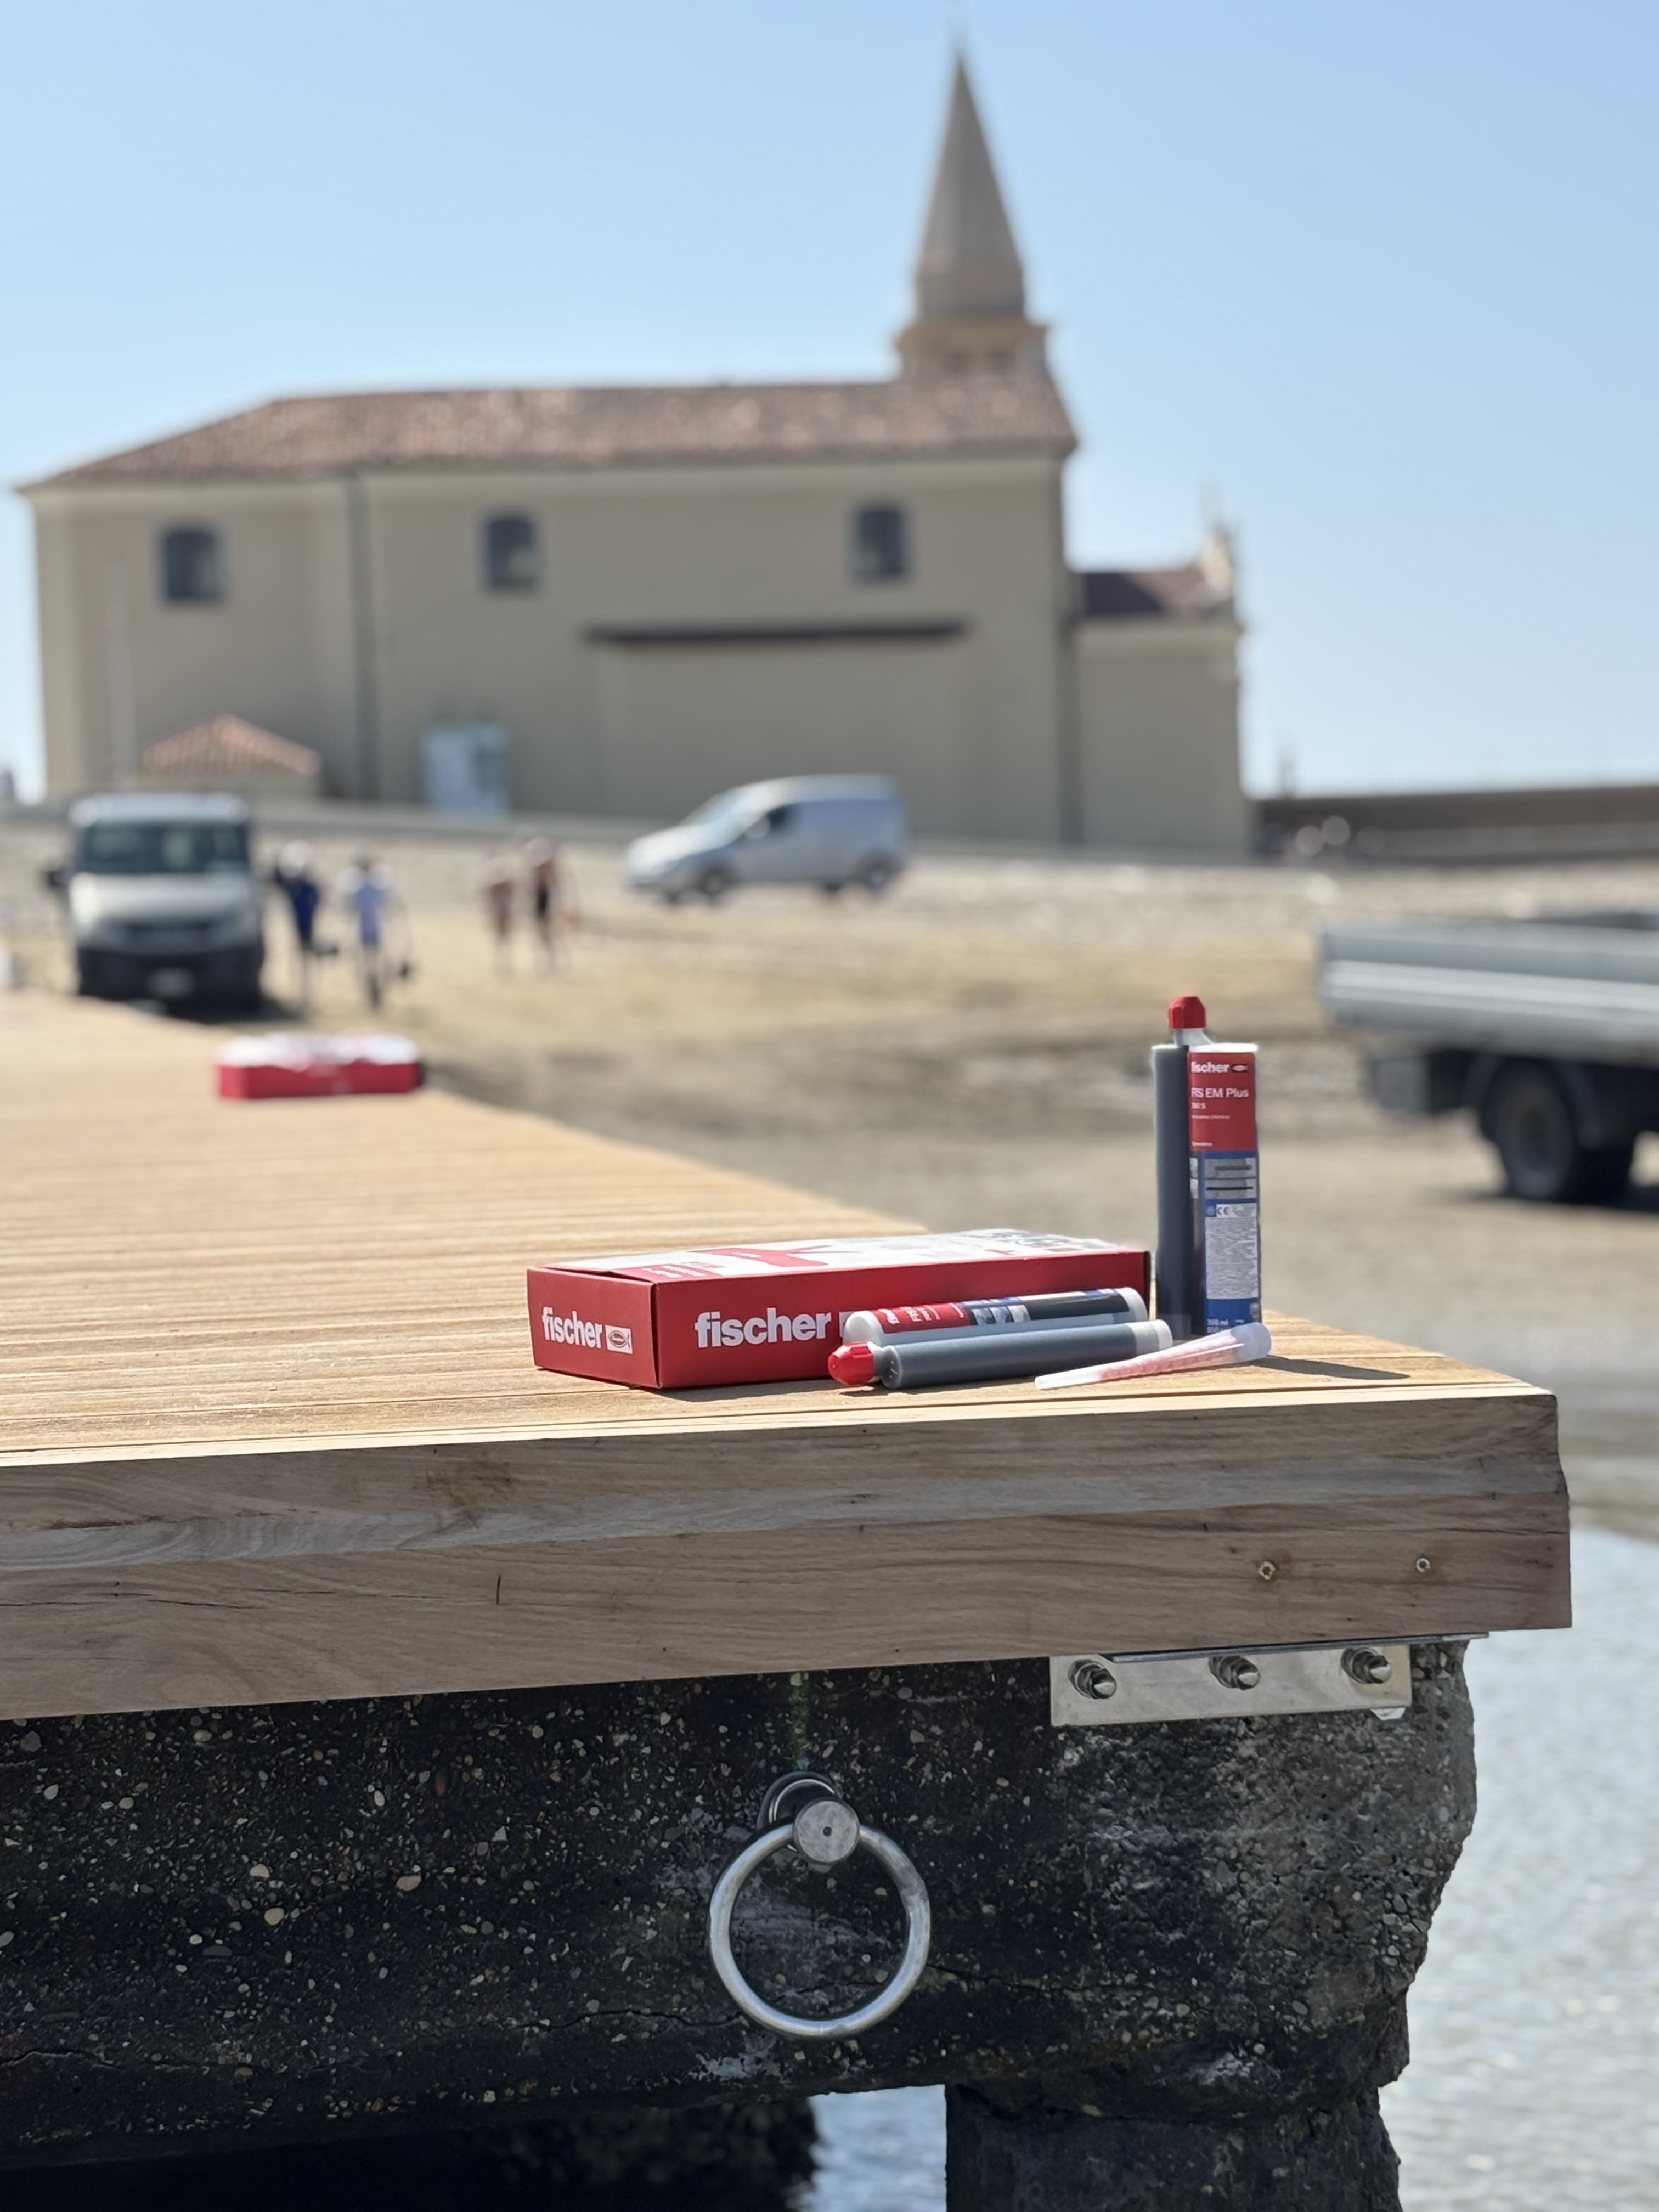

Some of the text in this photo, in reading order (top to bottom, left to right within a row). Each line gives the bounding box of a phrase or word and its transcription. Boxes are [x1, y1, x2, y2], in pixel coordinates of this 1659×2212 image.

[1205, 1088, 1223, 1098] EM
[1226, 1088, 1249, 1098] Plus
[541, 1306, 603, 1350] fischer
[695, 1307, 831, 1348] fischer
